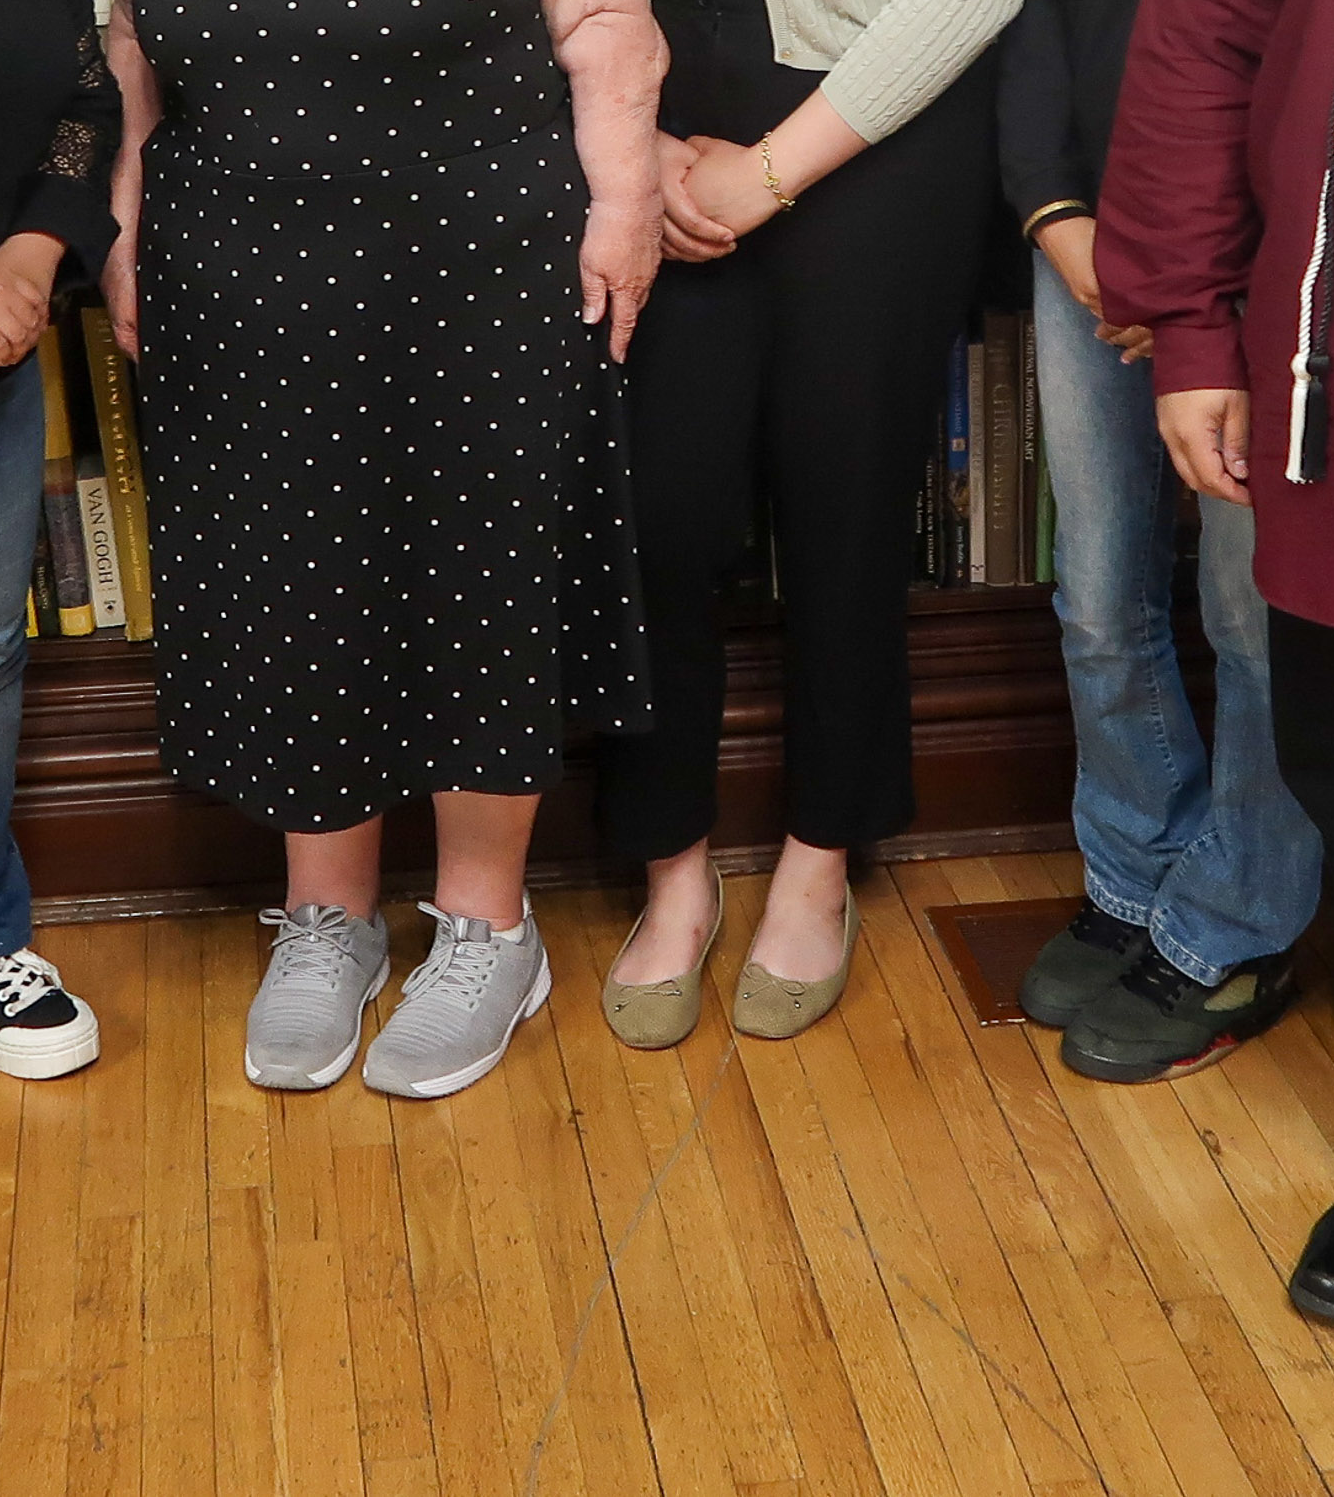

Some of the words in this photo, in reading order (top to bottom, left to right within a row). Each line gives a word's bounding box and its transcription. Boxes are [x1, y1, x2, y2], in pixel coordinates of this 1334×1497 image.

[1024, 377, 1034, 440] NORWEGIAN
[1024, 441, 1034, 462] ART
[87, 487, 107, 526] VAN
[92, 530, 114, 585] GOGH
